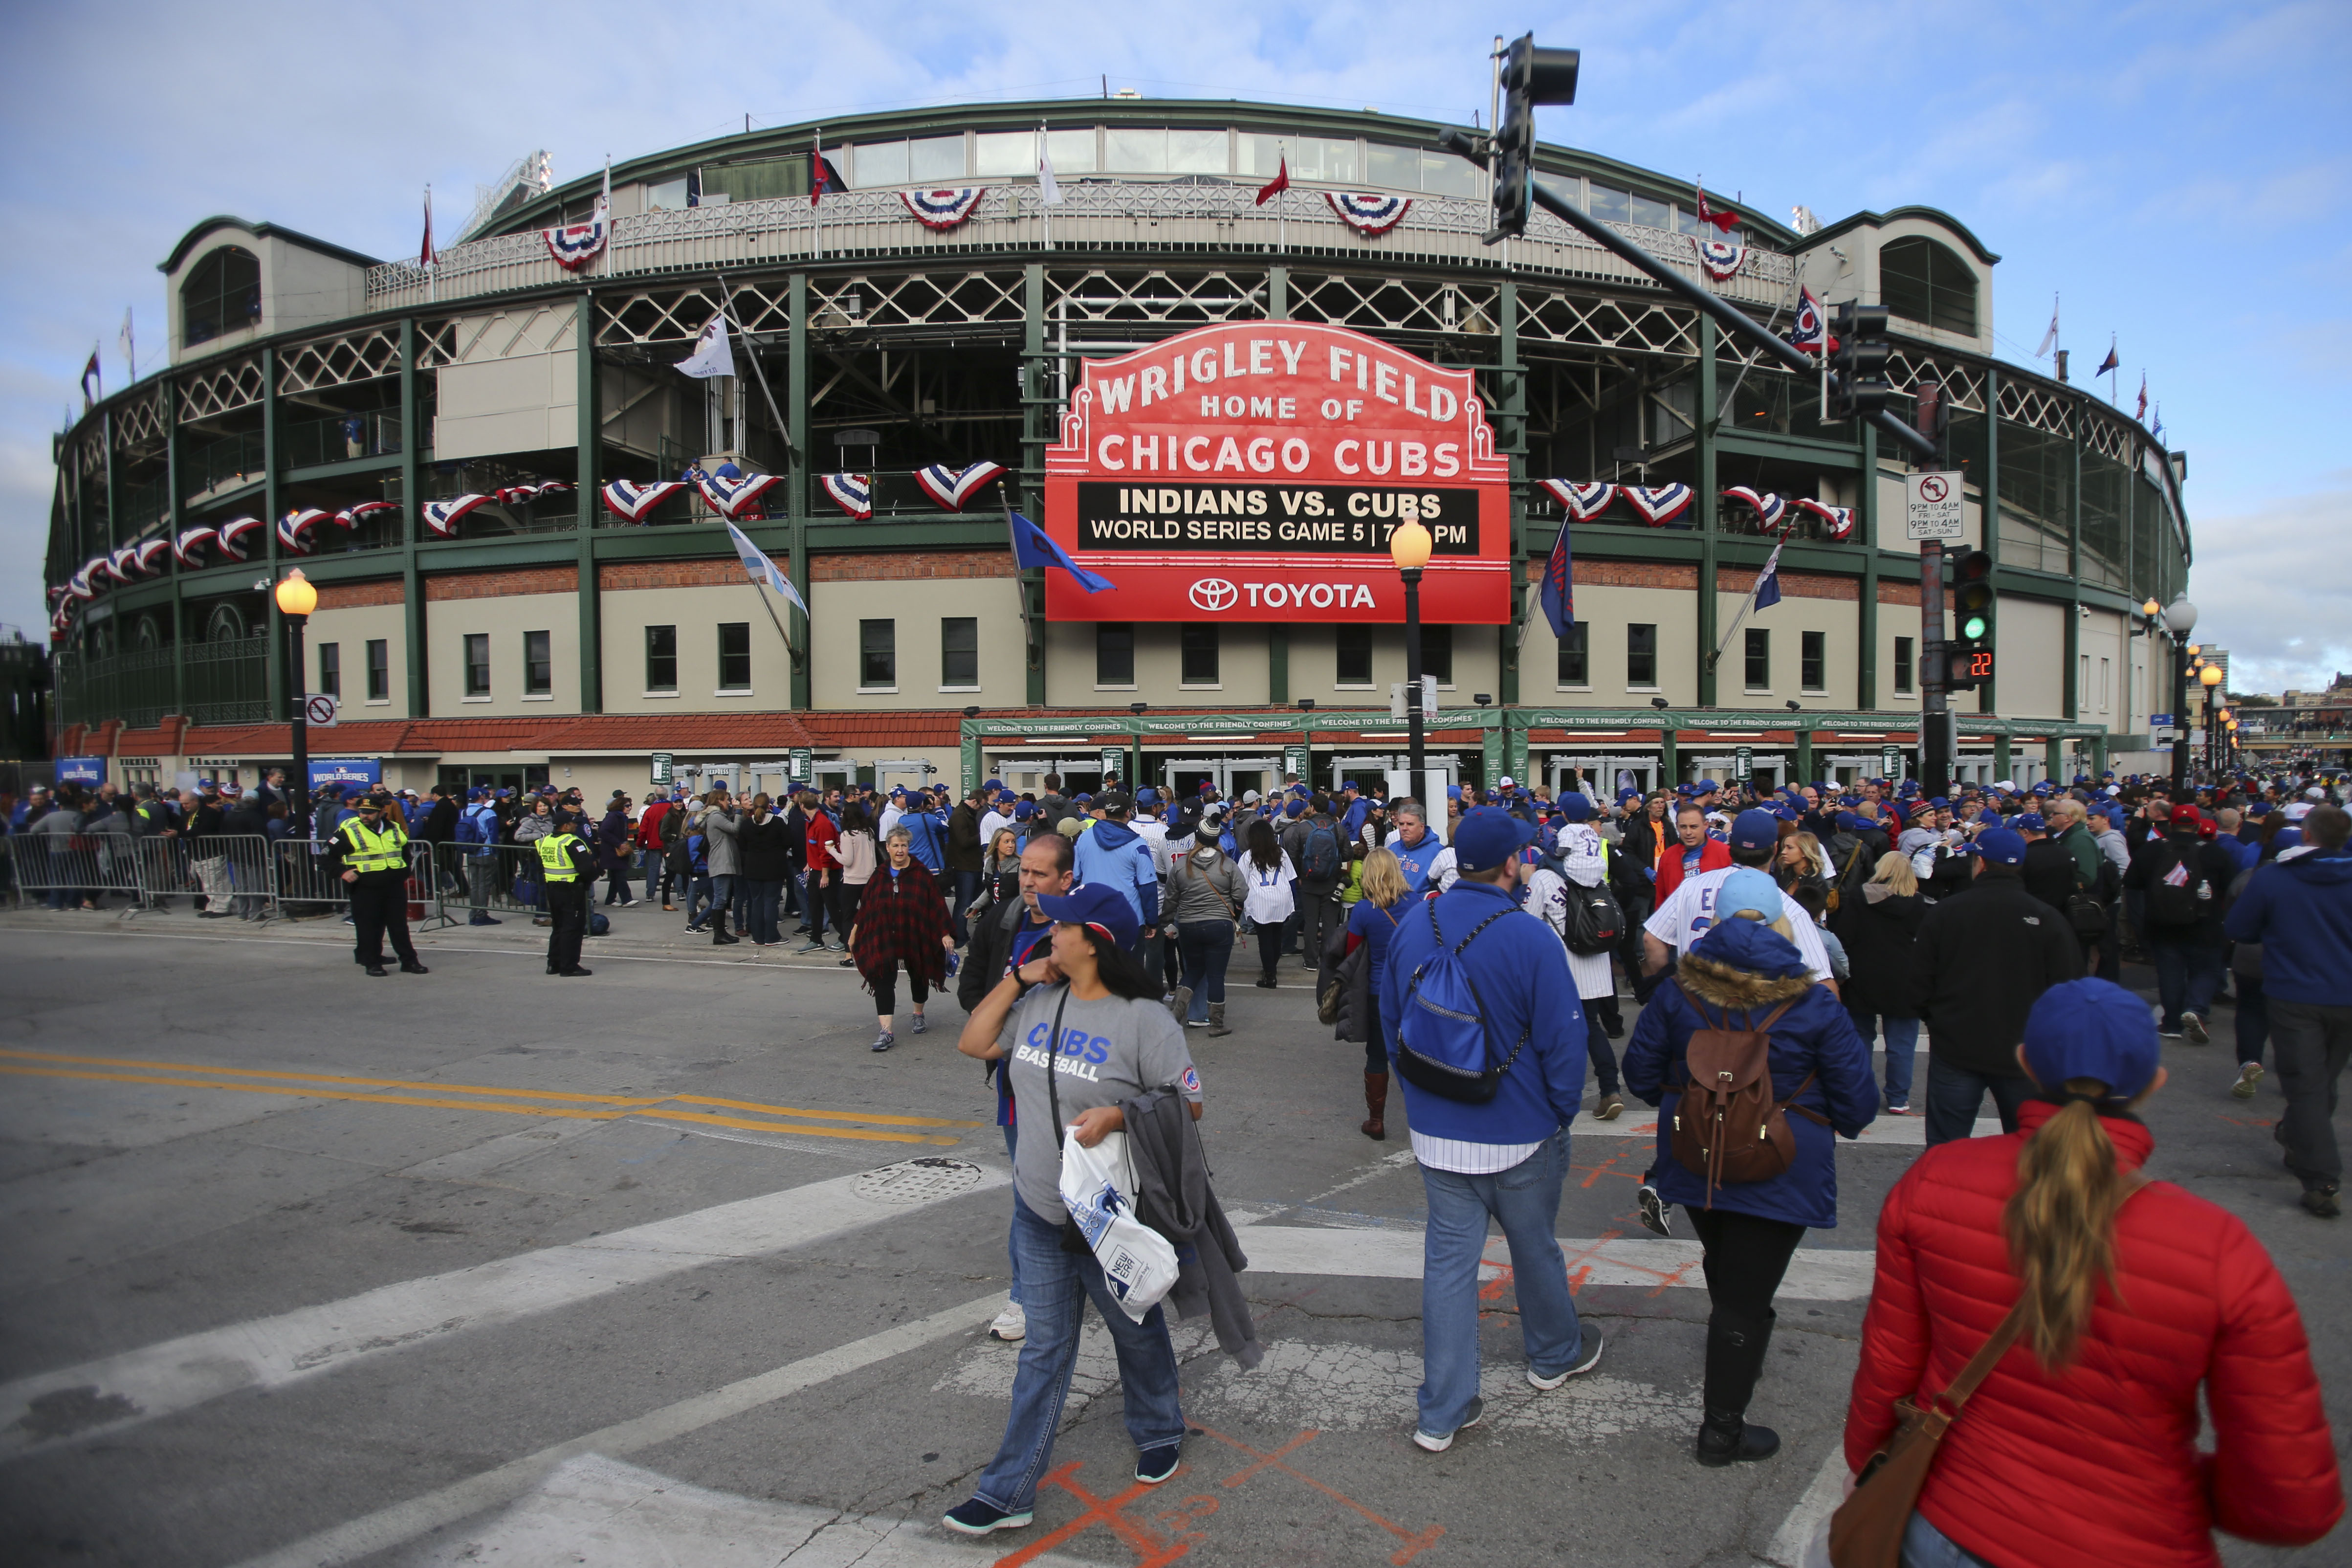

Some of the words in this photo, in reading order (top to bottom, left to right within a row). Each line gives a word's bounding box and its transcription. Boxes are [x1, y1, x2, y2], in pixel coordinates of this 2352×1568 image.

[1098, 340, 1306, 416] WRIGLEY
[1330, 346, 1458, 422] FIELD
[1202, 396, 1296, 419] HOME
[1321, 398, 1363, 420] OF
[1098, 434, 1310, 473] CHICAGO
[1335, 439, 1460, 477] CUBS
[1120, 489, 1268, 515] INDIANS
[1280, 491, 1335, 516] VS.
[1347, 492, 1441, 519] CUBS
[1091, 520, 1180, 539] WORLD
[1187, 520, 1272, 540] SERIES
[1278, 521, 1345, 541] GAME
[1353, 523, 1364, 541] 5
[1435, 525, 1466, 544] PM
[1243, 583, 1376, 609] TOYOTA
[1971, 653, 1992, 676] 22
[1432, 715, 1473, 724] CONFINES
[313, 773, 342, 783] WORLD
[342, 773, 369, 782] SERIES
[1585, 839, 1599, 856] 17
[1028, 1022, 1111, 1064] CUBS
[1016, 1044, 1099, 1082] BASEBALL
[1112, 1252, 1128, 1275] NEW
[1120, 1259, 1135, 1279] ERA
